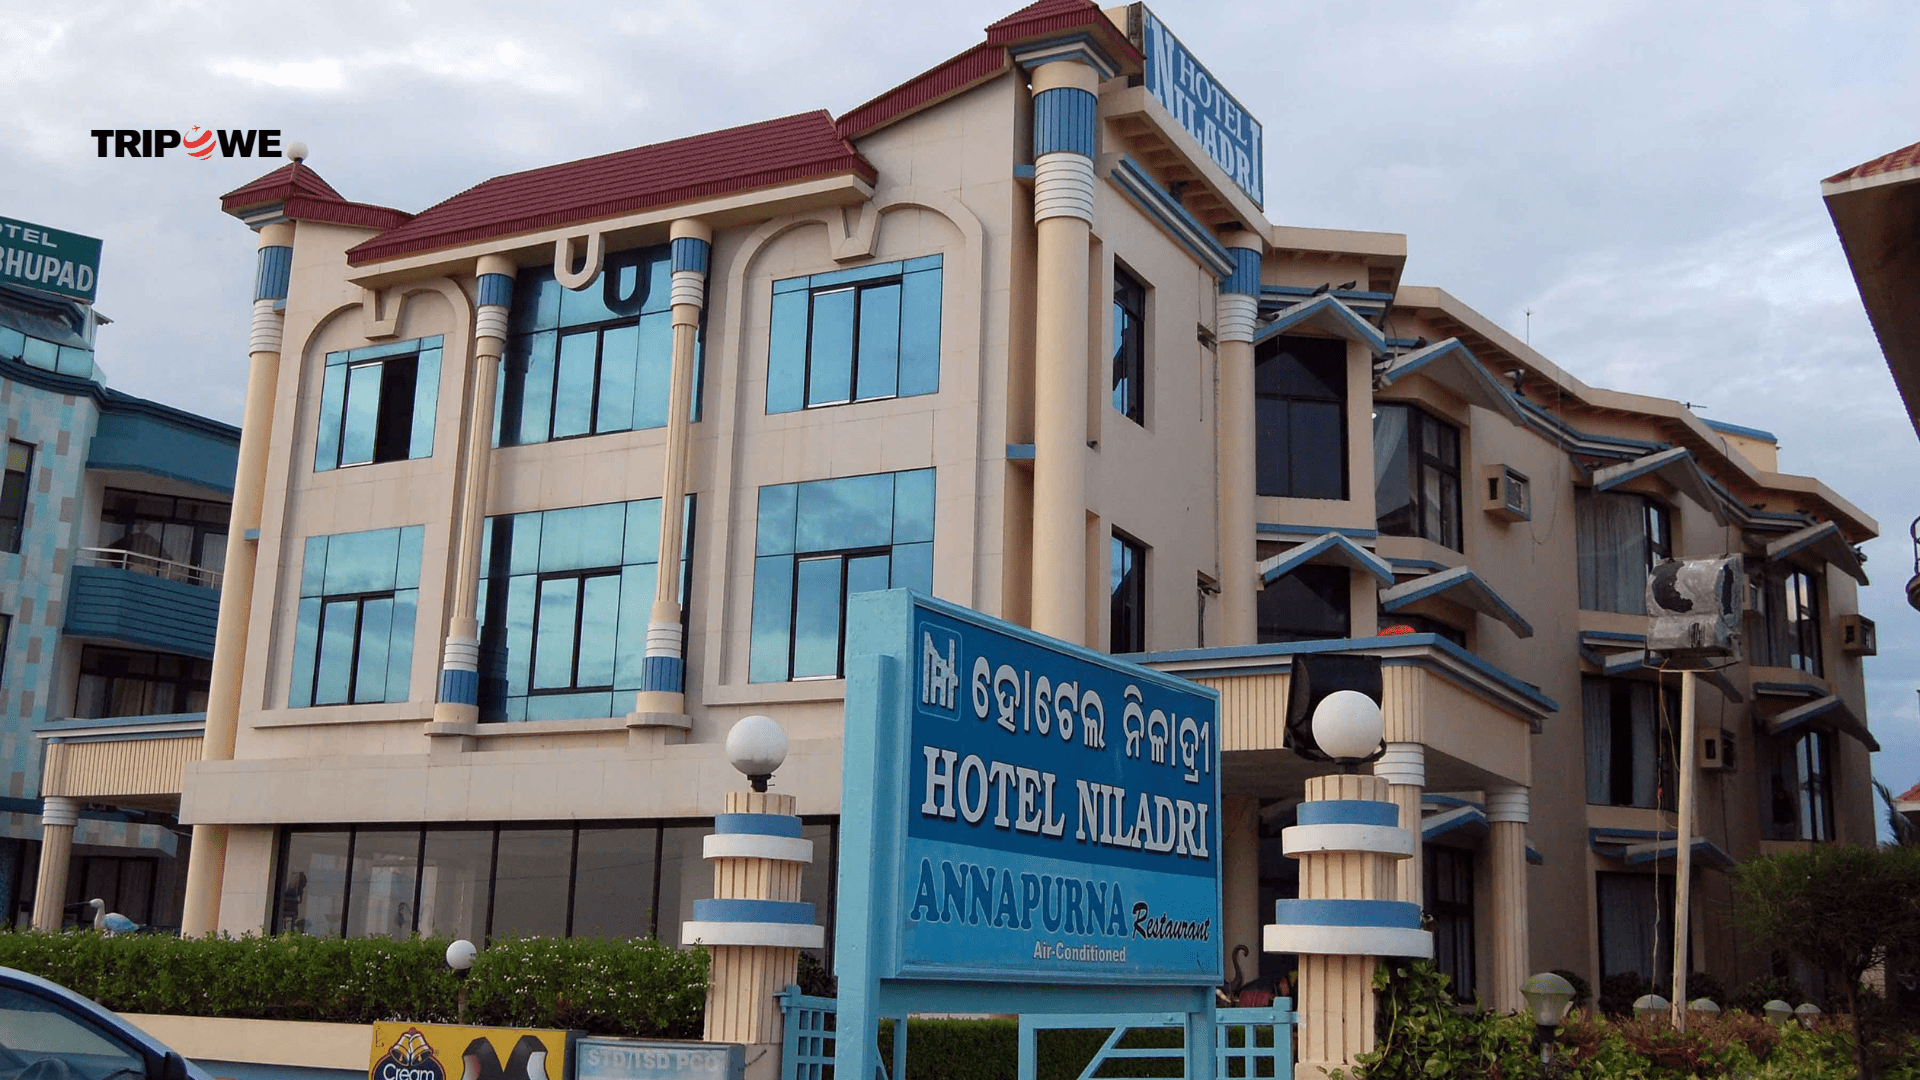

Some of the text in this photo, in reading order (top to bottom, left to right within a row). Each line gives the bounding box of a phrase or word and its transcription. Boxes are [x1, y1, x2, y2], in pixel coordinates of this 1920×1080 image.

[1151, 14, 1262, 204] NILADRI
[1179, 50, 1248, 146] HOTEL
[0, 222, 57, 248] TEL
[972, 656, 1106, 749] ହୋଟେଲ
[921, 746, 1209, 857] HOTEL NILADRI
[910, 857, 1211, 942] ANNAPURNA Restaurant
[1033, 940, 1127, 963] Air-Conditioned
[383, 1063, 435, 1080] Cream
[588, 1050, 670, 1070] STD/ISD
